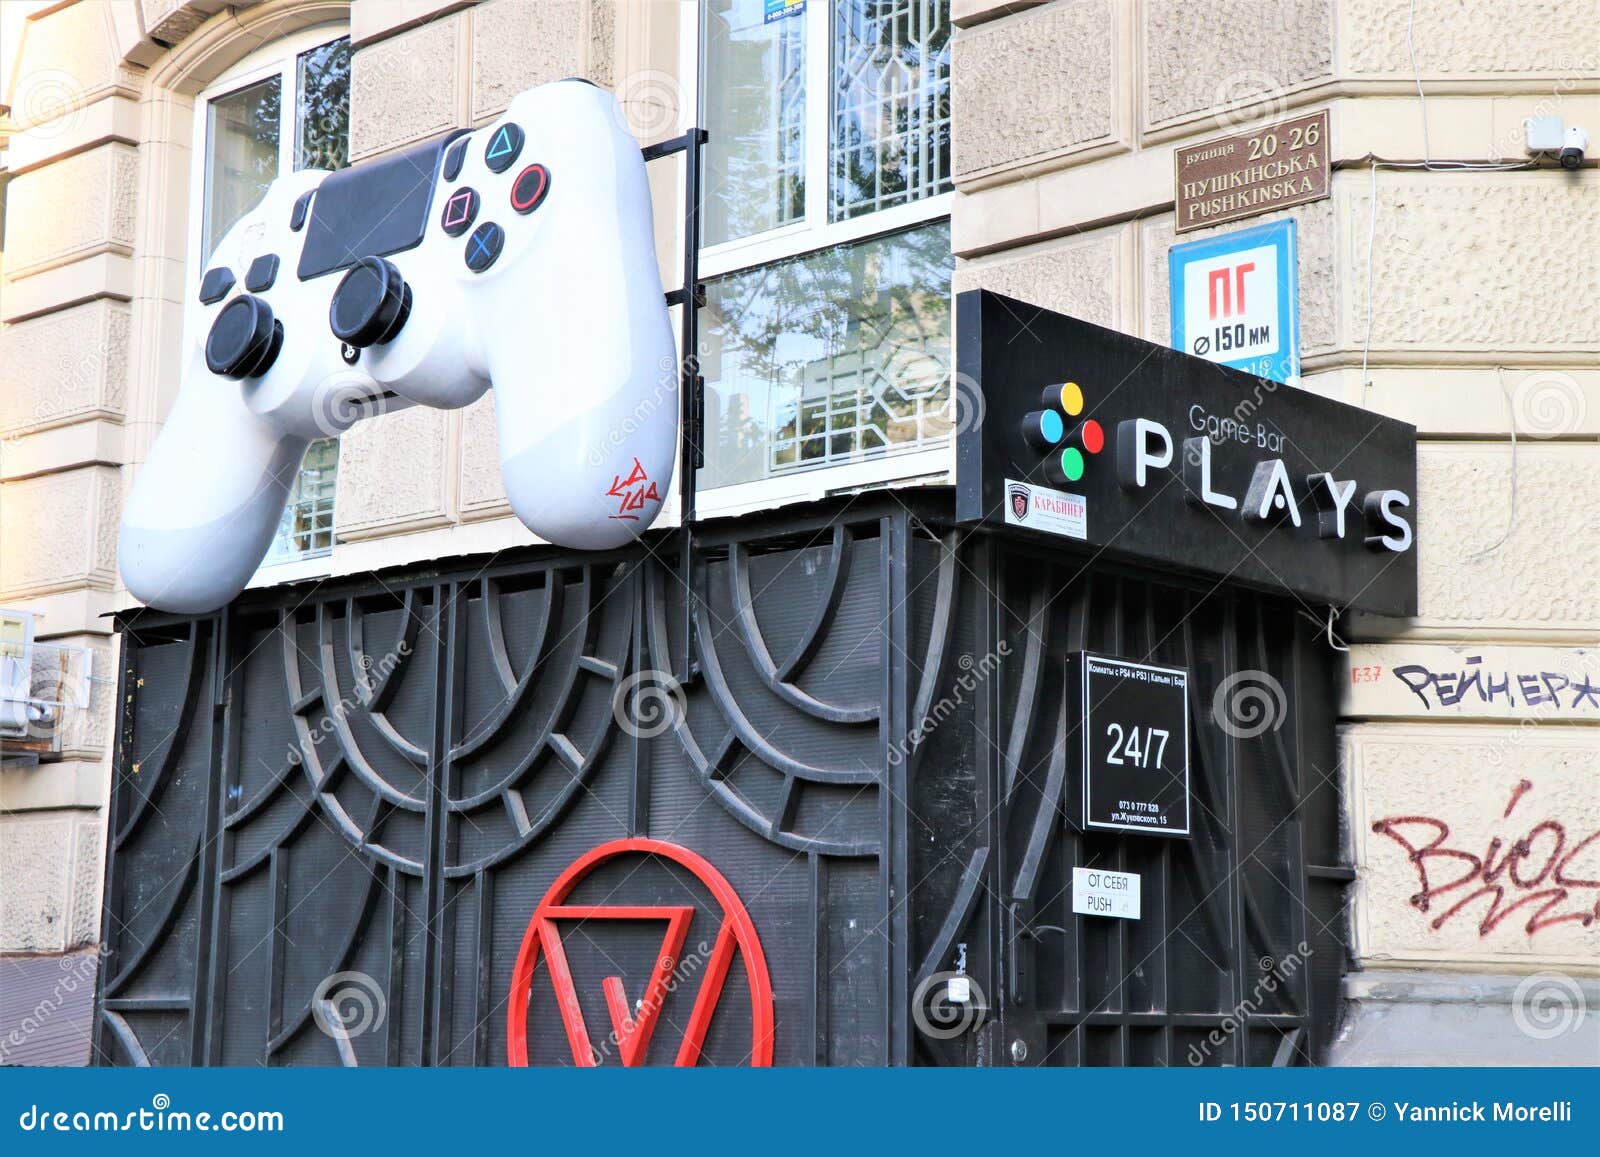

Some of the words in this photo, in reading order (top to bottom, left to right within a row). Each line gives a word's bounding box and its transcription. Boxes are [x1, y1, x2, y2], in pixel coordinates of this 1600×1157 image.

[1184, 152, 1319, 200] ПУШКІНСЬКА
[1189, 176, 1313, 220] PUSHKINSKA
[1208, 262, 1255, 321] ПГ
[1215, 323, 1245, 352] 150
[1189, 404, 1287, 453] Game-Bar
[1128, 418, 1413, 552] PLAYS
[1034, 495, 1084, 518] КАРАБИНЕР
[1174, 676, 1185, 688] Бар
[1106, 722, 1170, 769] 24/7
[1118, 800, 1131, 810] 073
[1136, 802, 1147, 812] 777
[1159, 815, 1167, 825] 15
[1088, 874, 1101, 889] ОТ
[1103, 875, 1128, 891] СЕБЯ
[1087, 895, 1112, 912] PUSH
